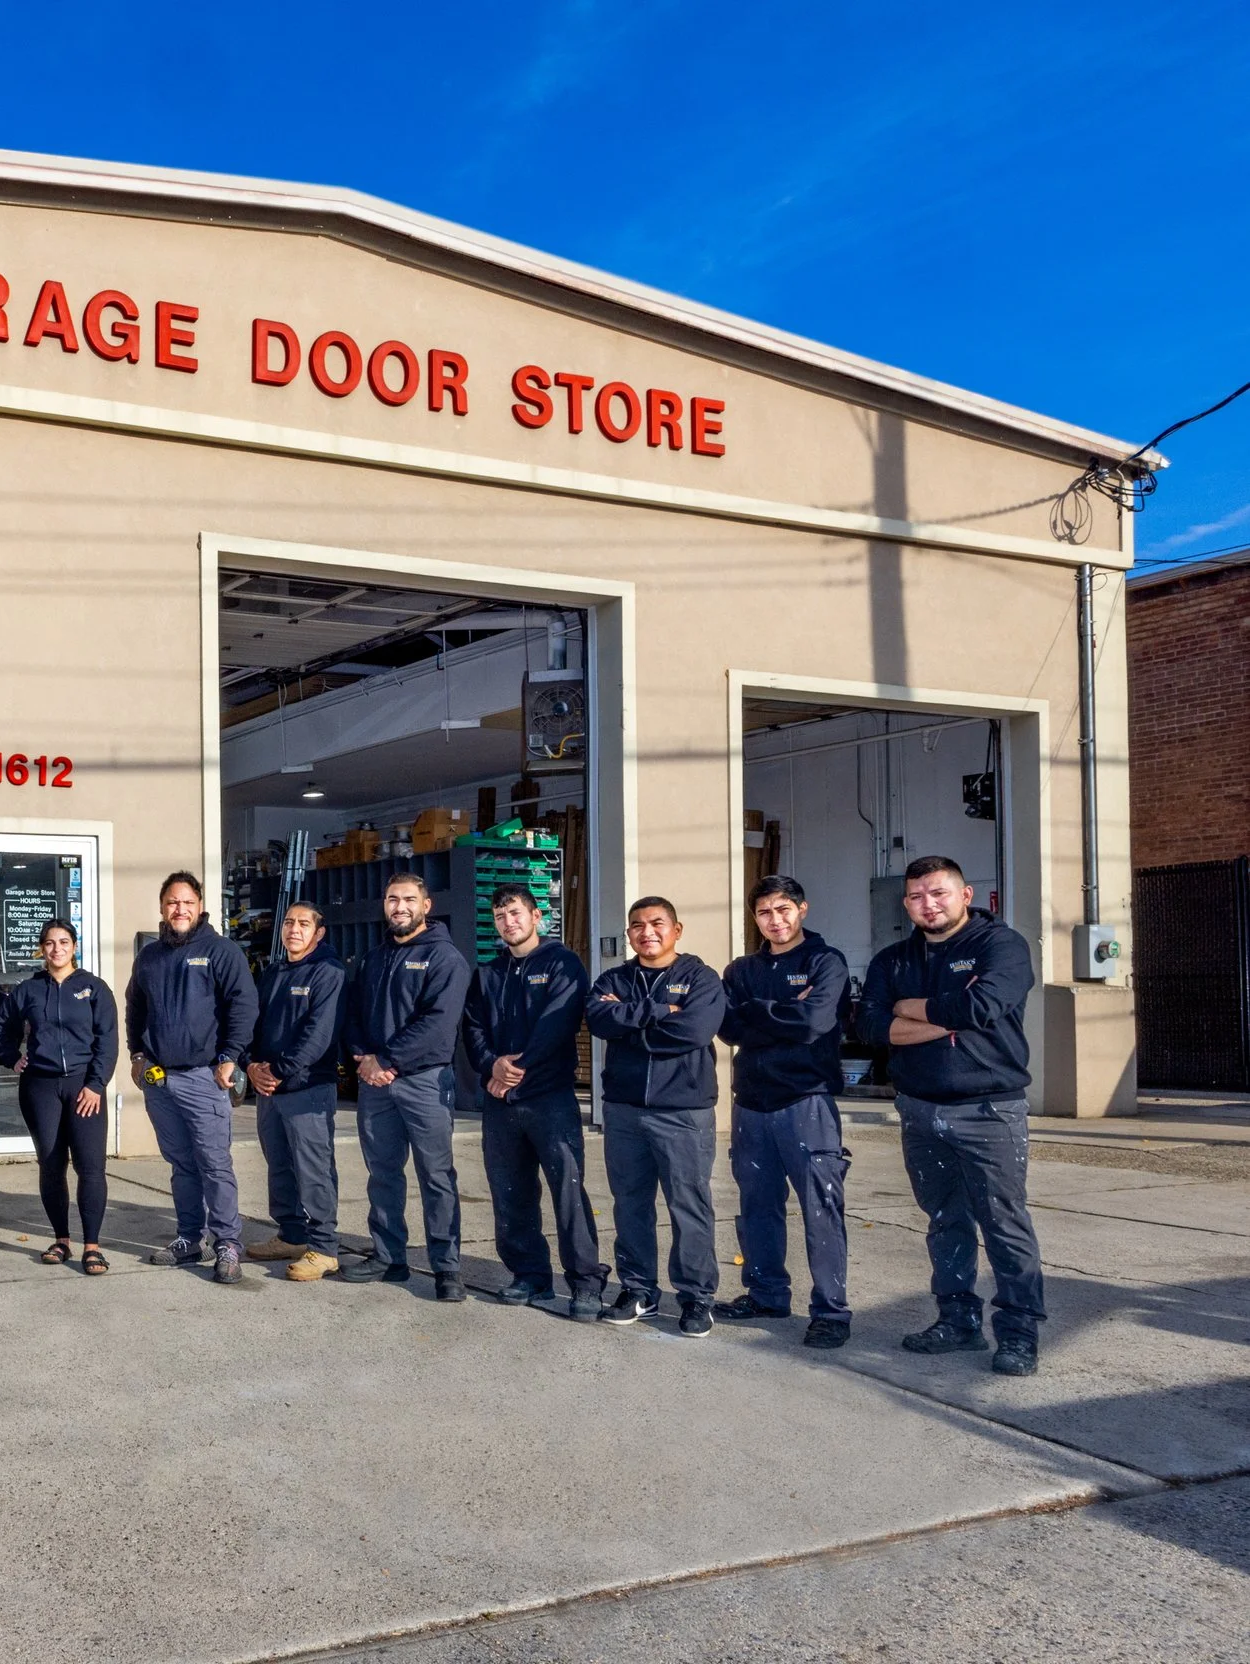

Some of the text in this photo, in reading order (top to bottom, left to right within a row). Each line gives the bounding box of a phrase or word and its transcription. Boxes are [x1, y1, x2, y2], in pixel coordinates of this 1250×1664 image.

[252, 317, 469, 417] DOOR
[511, 364, 726, 458] STORE
[18, 920, 44, 928] Saturday
